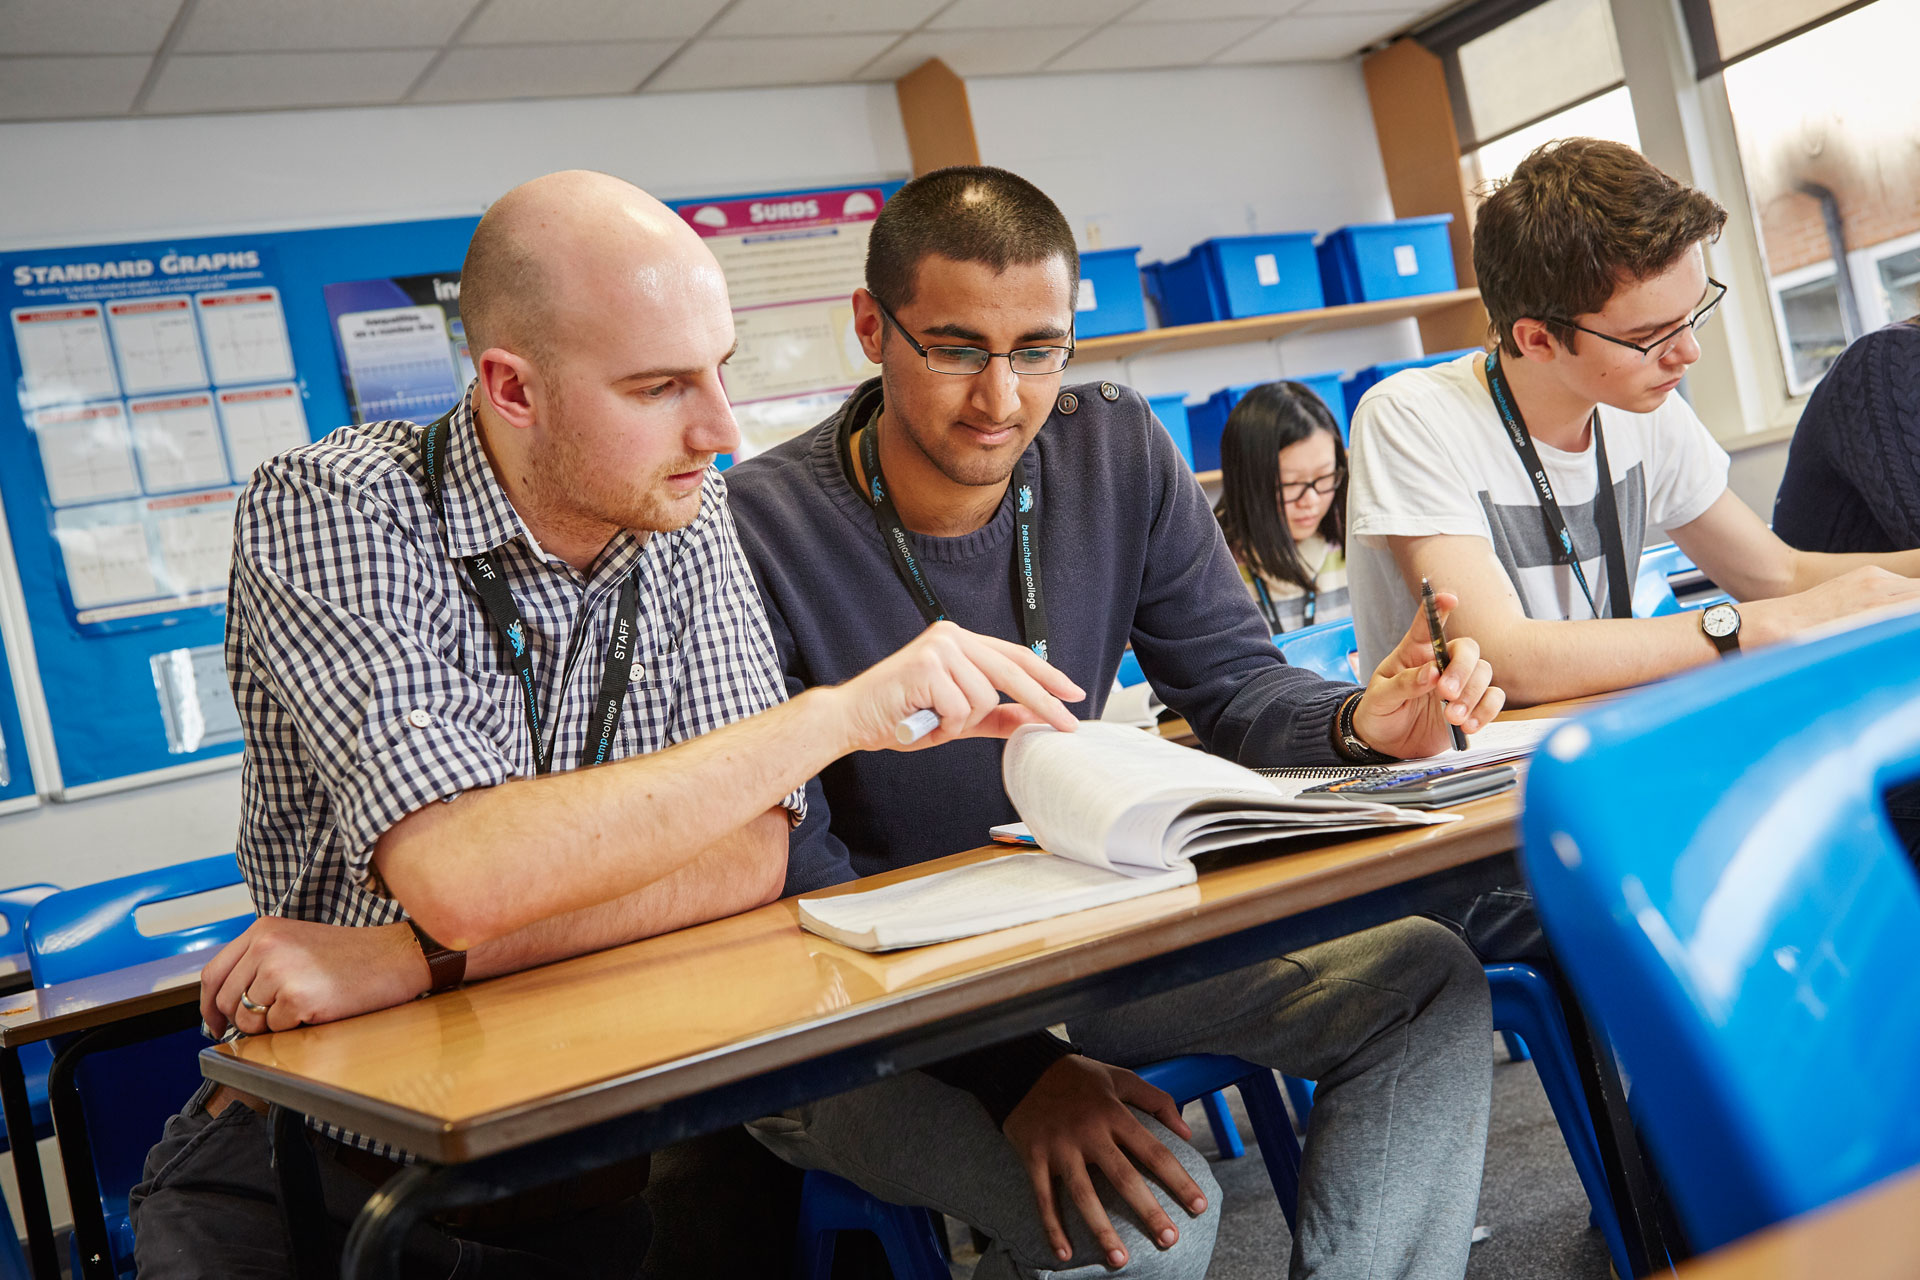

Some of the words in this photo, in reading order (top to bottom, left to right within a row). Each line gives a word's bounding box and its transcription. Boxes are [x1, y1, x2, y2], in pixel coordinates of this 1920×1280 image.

[749, 200, 820, 223] SURDS
[13, 259, 154, 285] STANDARD
[160, 251, 260, 275] GRAPHS
[1535, 470, 1553, 502] STAFF
[473, 557, 497, 580] AFF
[1020, 524, 1037, 610] beauchampcollege
[614, 618, 631, 661] STAFF
